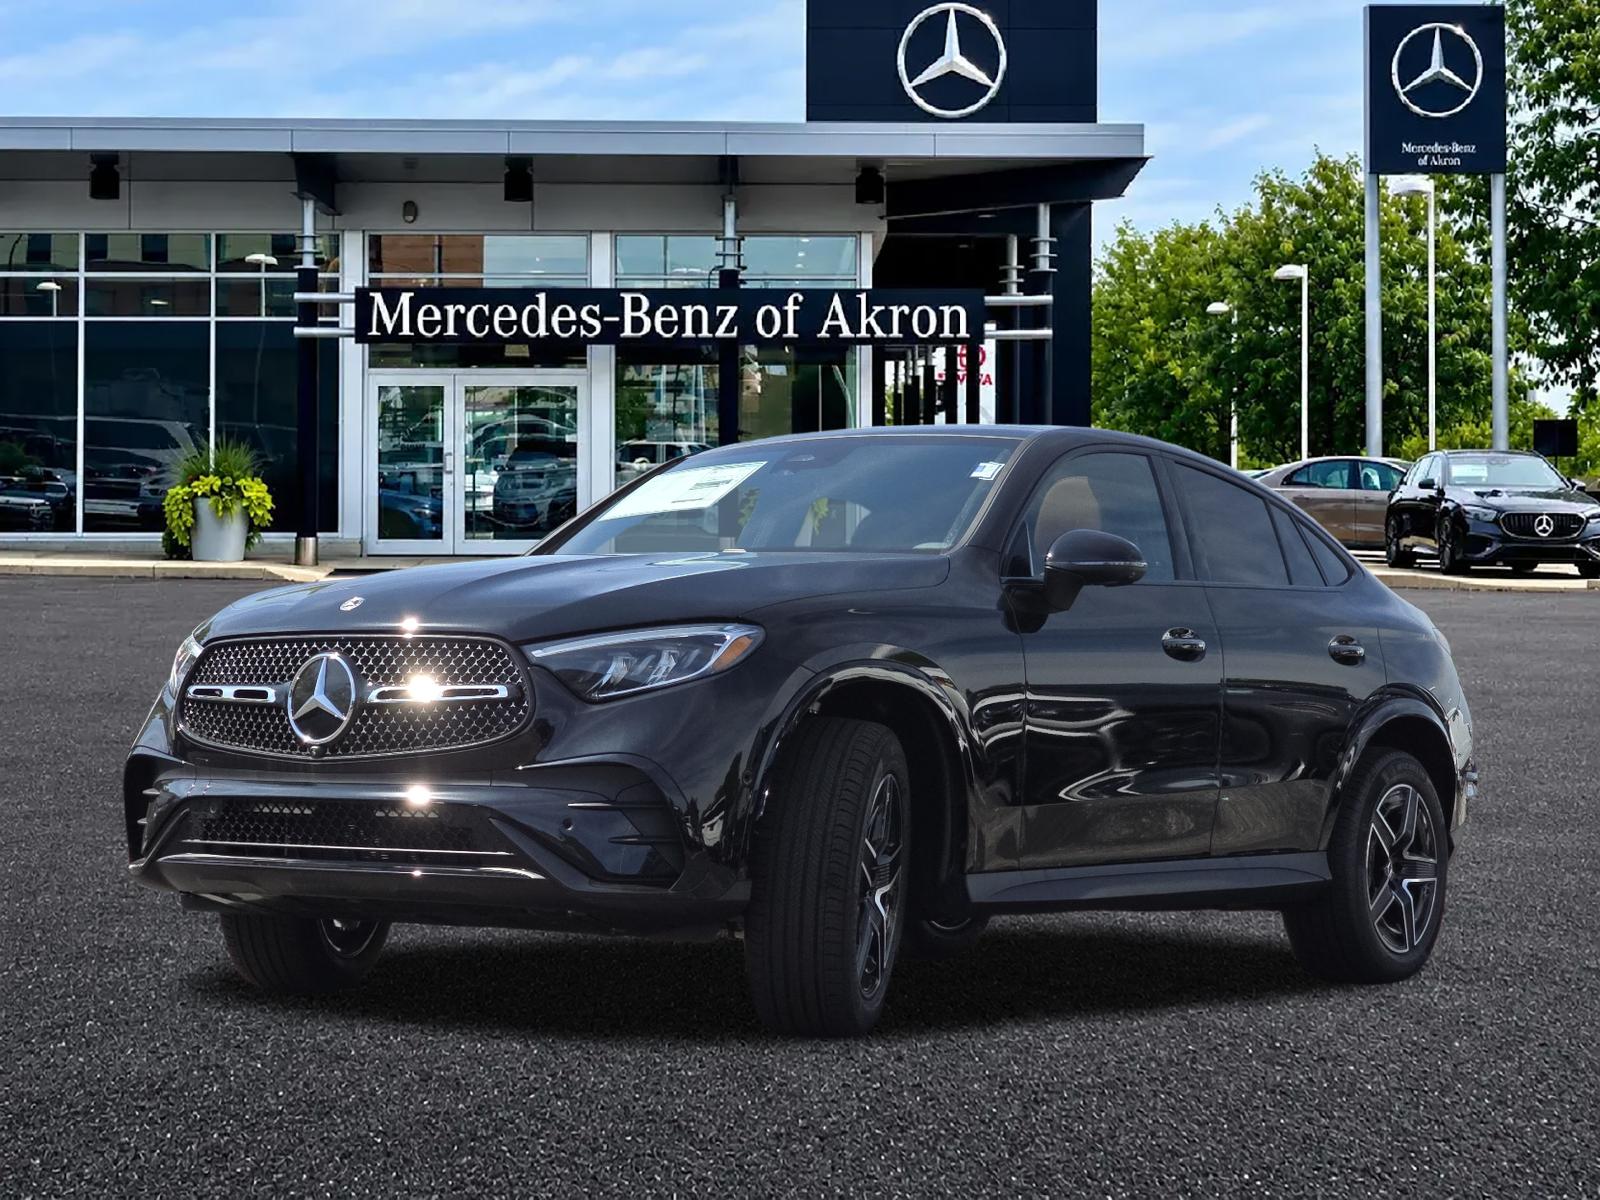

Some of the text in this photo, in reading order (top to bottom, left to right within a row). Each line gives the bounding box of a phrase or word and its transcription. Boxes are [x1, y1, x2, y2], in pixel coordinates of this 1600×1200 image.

[1401, 141, 1476, 153] Mercedes-Benz
[1417, 154, 1461, 166] of Akron
[367, 292, 969, 337] Mercedes-Benz of Akron
